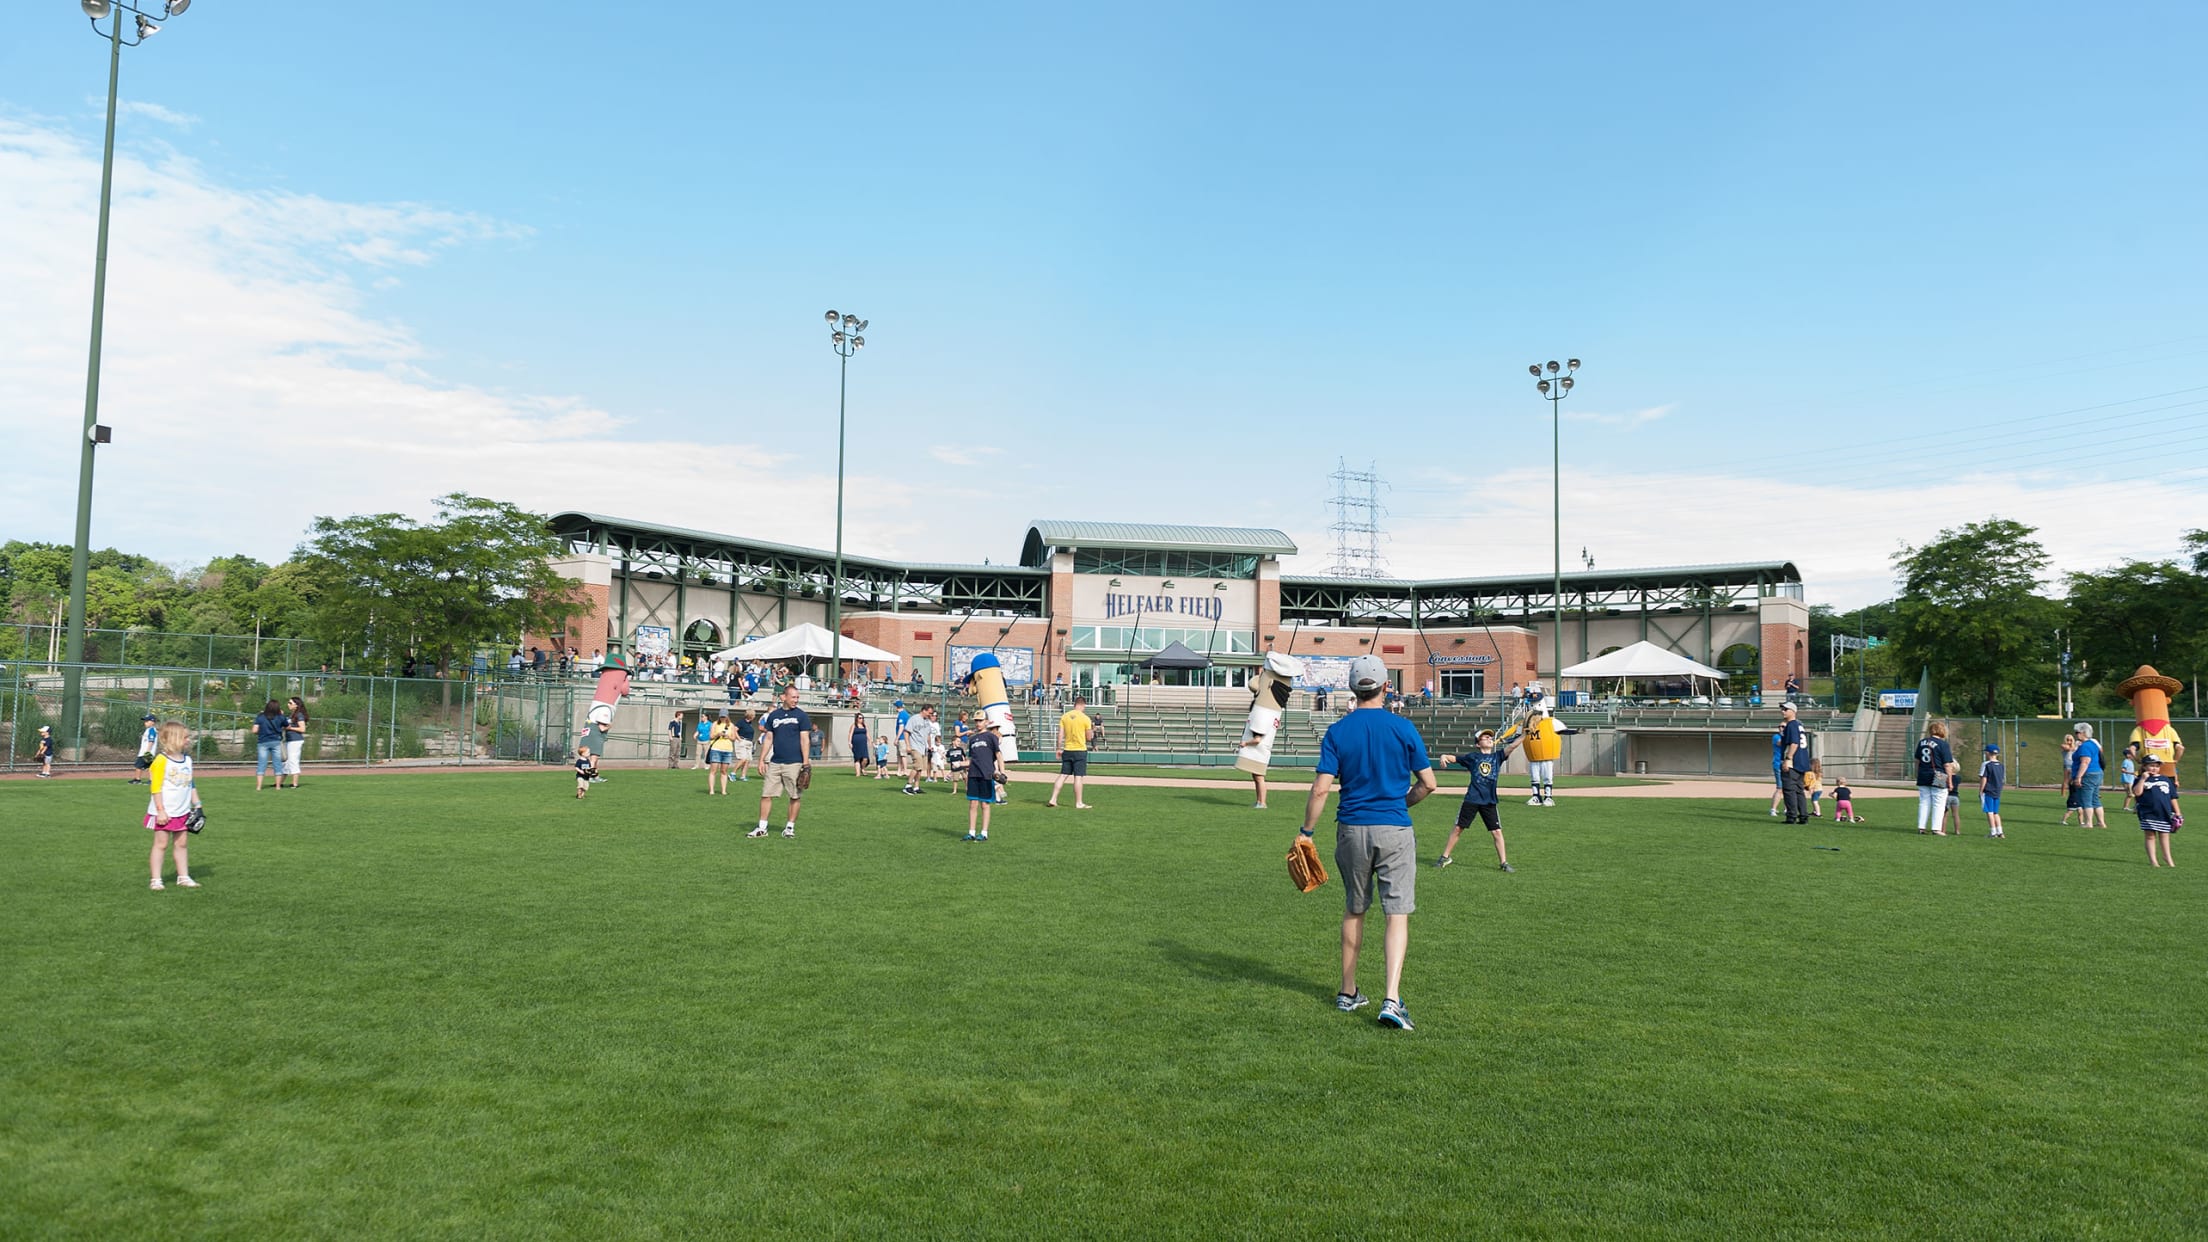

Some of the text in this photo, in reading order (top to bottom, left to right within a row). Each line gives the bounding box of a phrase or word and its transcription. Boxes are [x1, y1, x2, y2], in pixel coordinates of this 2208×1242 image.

[1105, 592, 1223, 622] HELFAER FIELD
[1921, 747, 1932, 763] 8
